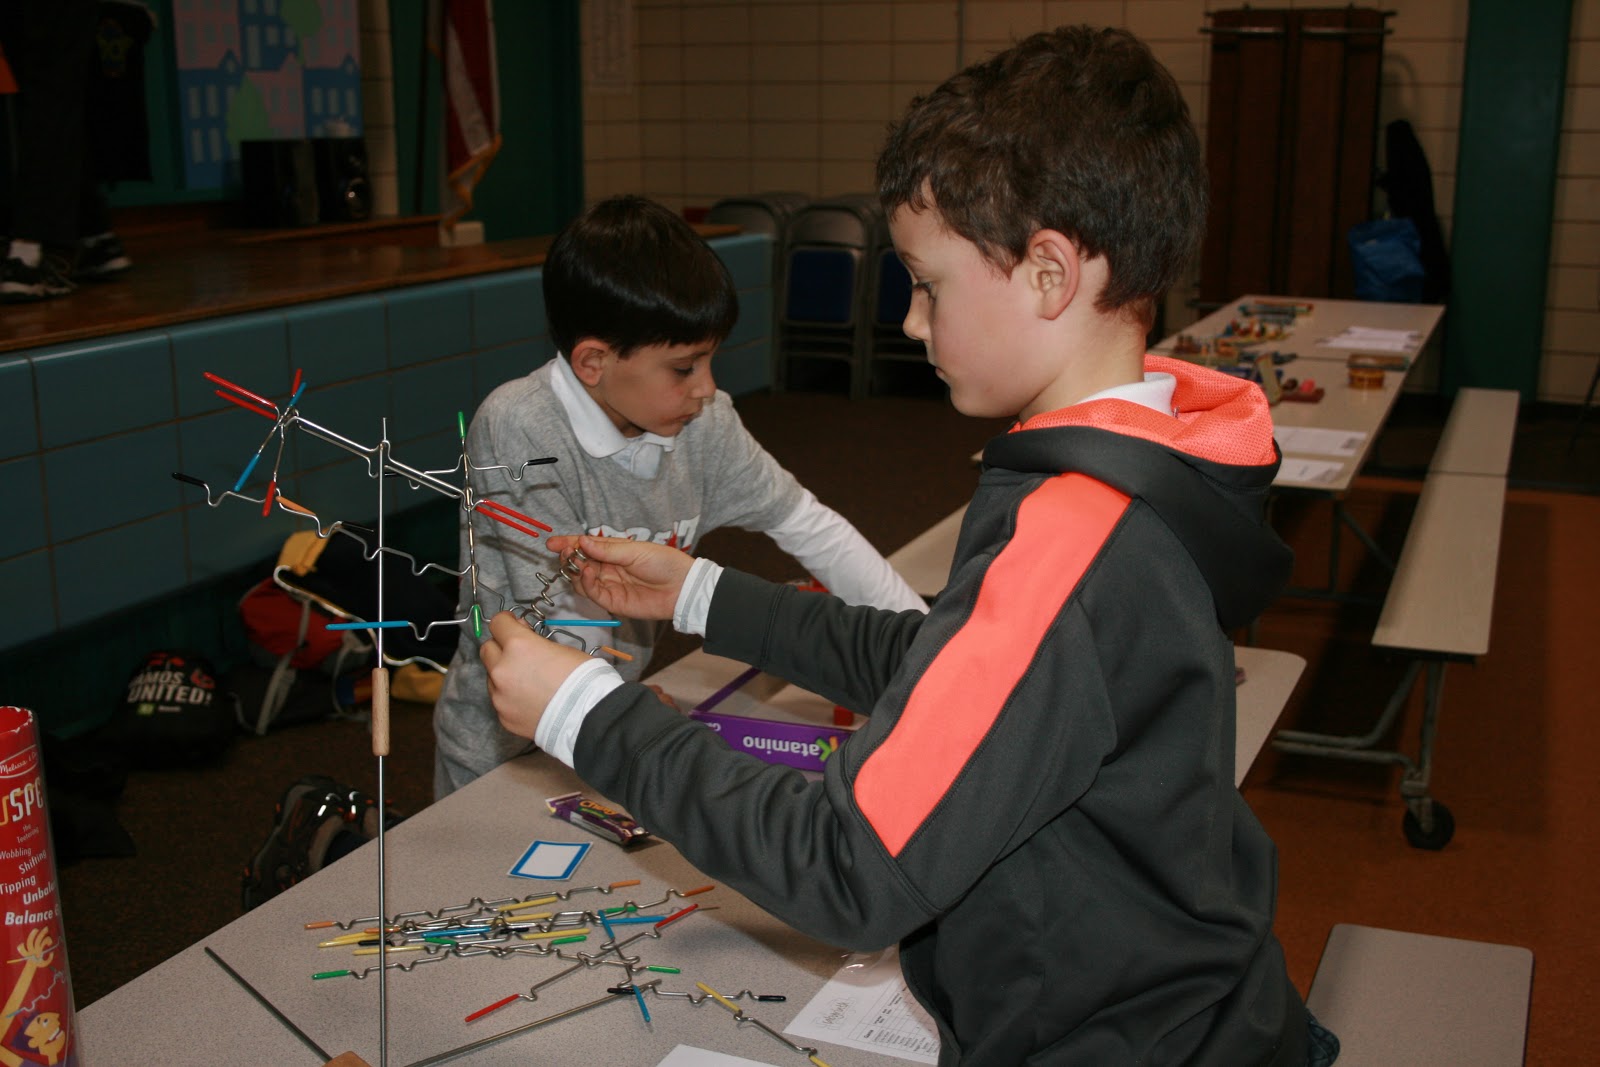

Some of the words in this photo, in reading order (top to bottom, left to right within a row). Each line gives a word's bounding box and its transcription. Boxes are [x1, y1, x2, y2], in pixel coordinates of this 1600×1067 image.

[743, 735, 838, 762] Katamino
[0, 847, 32, 860] Wobbling
[18, 849, 47, 875] Shifting
[0, 875, 37, 895] Tipping
[5, 909, 53, 926] Balance
